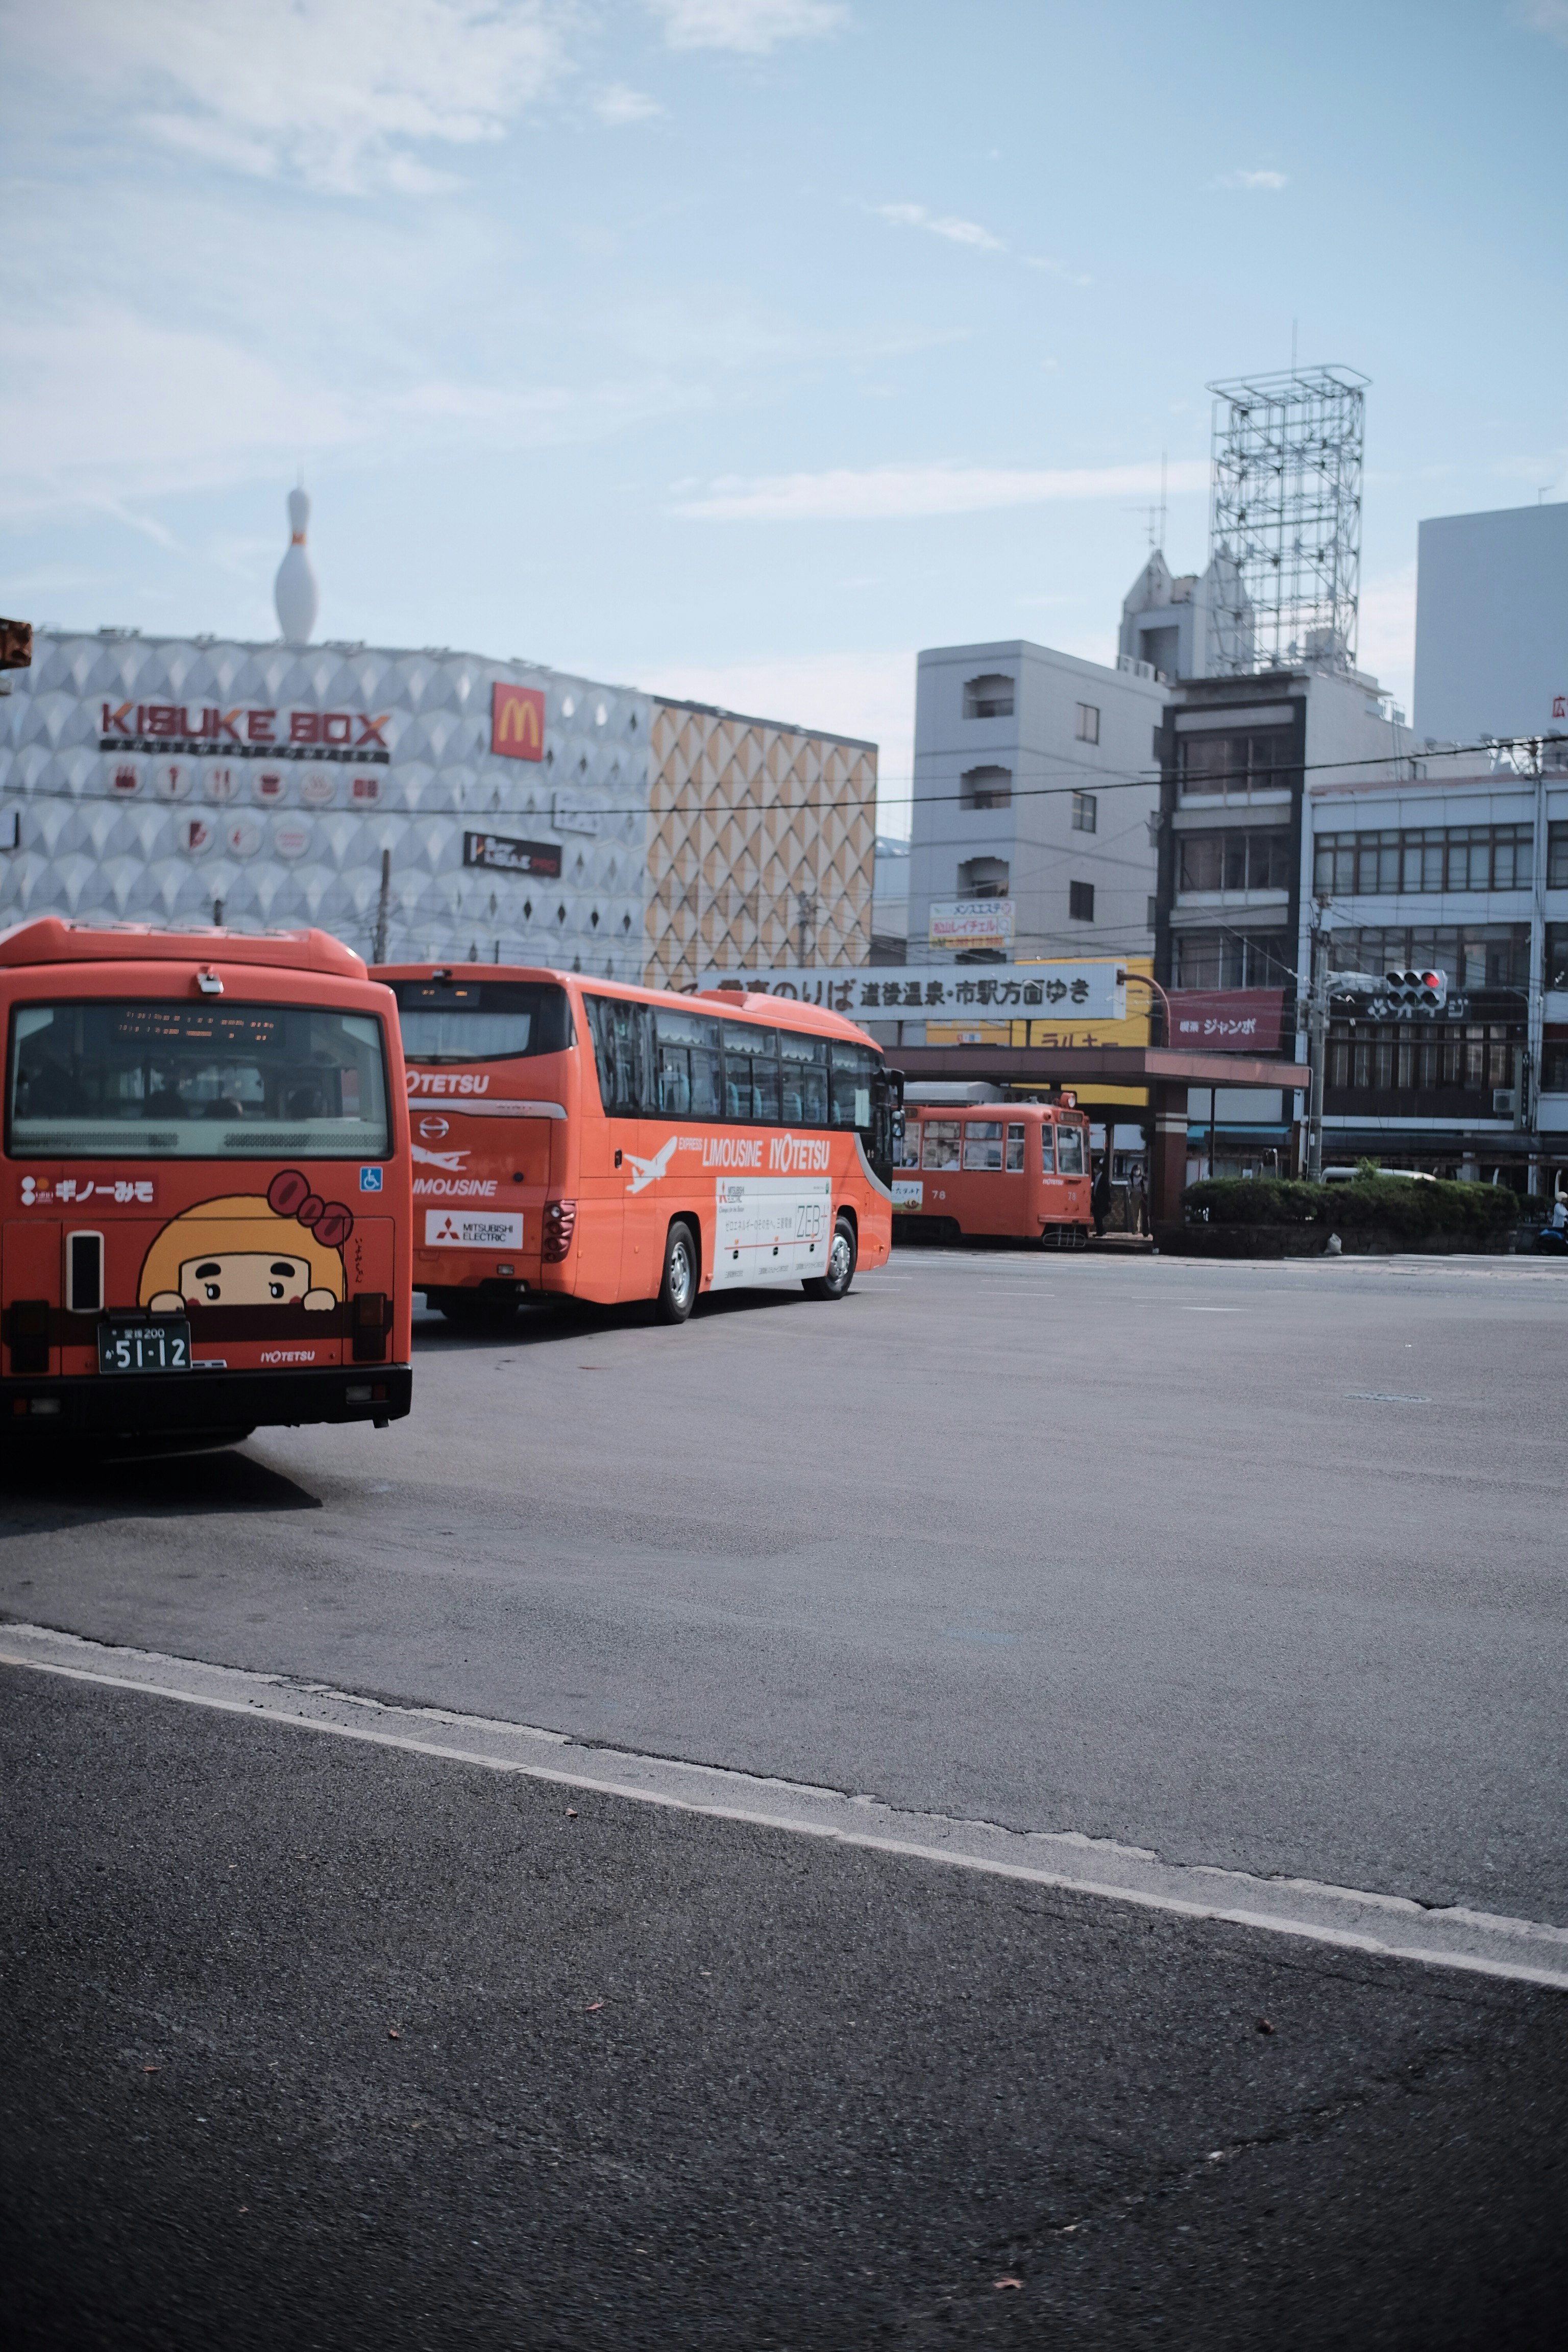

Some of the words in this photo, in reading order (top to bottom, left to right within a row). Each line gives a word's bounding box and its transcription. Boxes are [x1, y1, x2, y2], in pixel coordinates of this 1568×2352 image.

[1552, 696, 1568, 718] 広
[103, 702, 276, 742] KISUKE
[289, 712, 391, 748] BOX
[1204, 1017, 1257, 1035] ジャンボ
[679, 1137, 702, 1151] EXPRESS
[702, 1138, 763, 1167] LIMOUSINE
[769, 1133, 830, 1173] IYOTETSU
[56, 1179, 154, 1203] ギノーみそ
[932, 1190, 946, 1200] 78
[463, 1223, 513, 1233] MITSUBISHI
[463, 1233, 506, 1242] ELECTRIC
[260, 1350, 315, 1363] IYOTETSU
